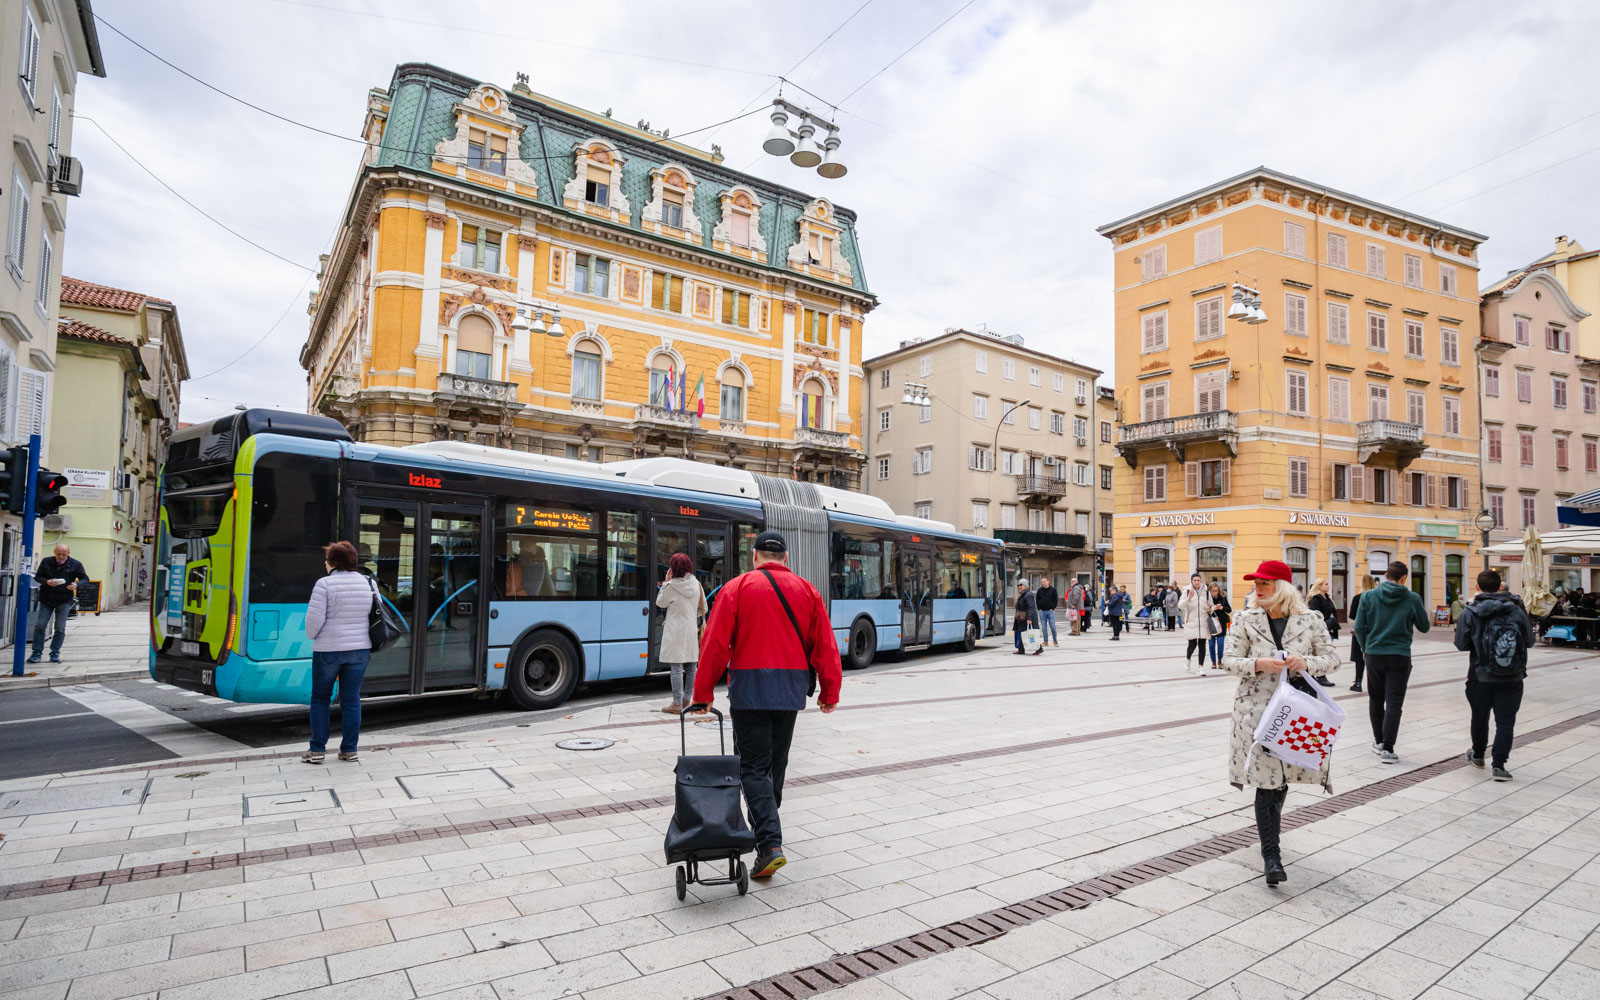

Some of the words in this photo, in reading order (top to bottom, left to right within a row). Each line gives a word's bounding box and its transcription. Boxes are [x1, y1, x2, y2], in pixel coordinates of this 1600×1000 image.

[408, 472, 442, 488] Izlaz
[516, 507, 526, 525] 7
[679, 505, 700, 517] Izlaz
[1153, 512, 1215, 527] SWAROVSKI
[1300, 512, 1349, 527] SWAROVSKI
[201, 669, 213, 685] 817
[1263, 705, 1292, 742] CROATIA
